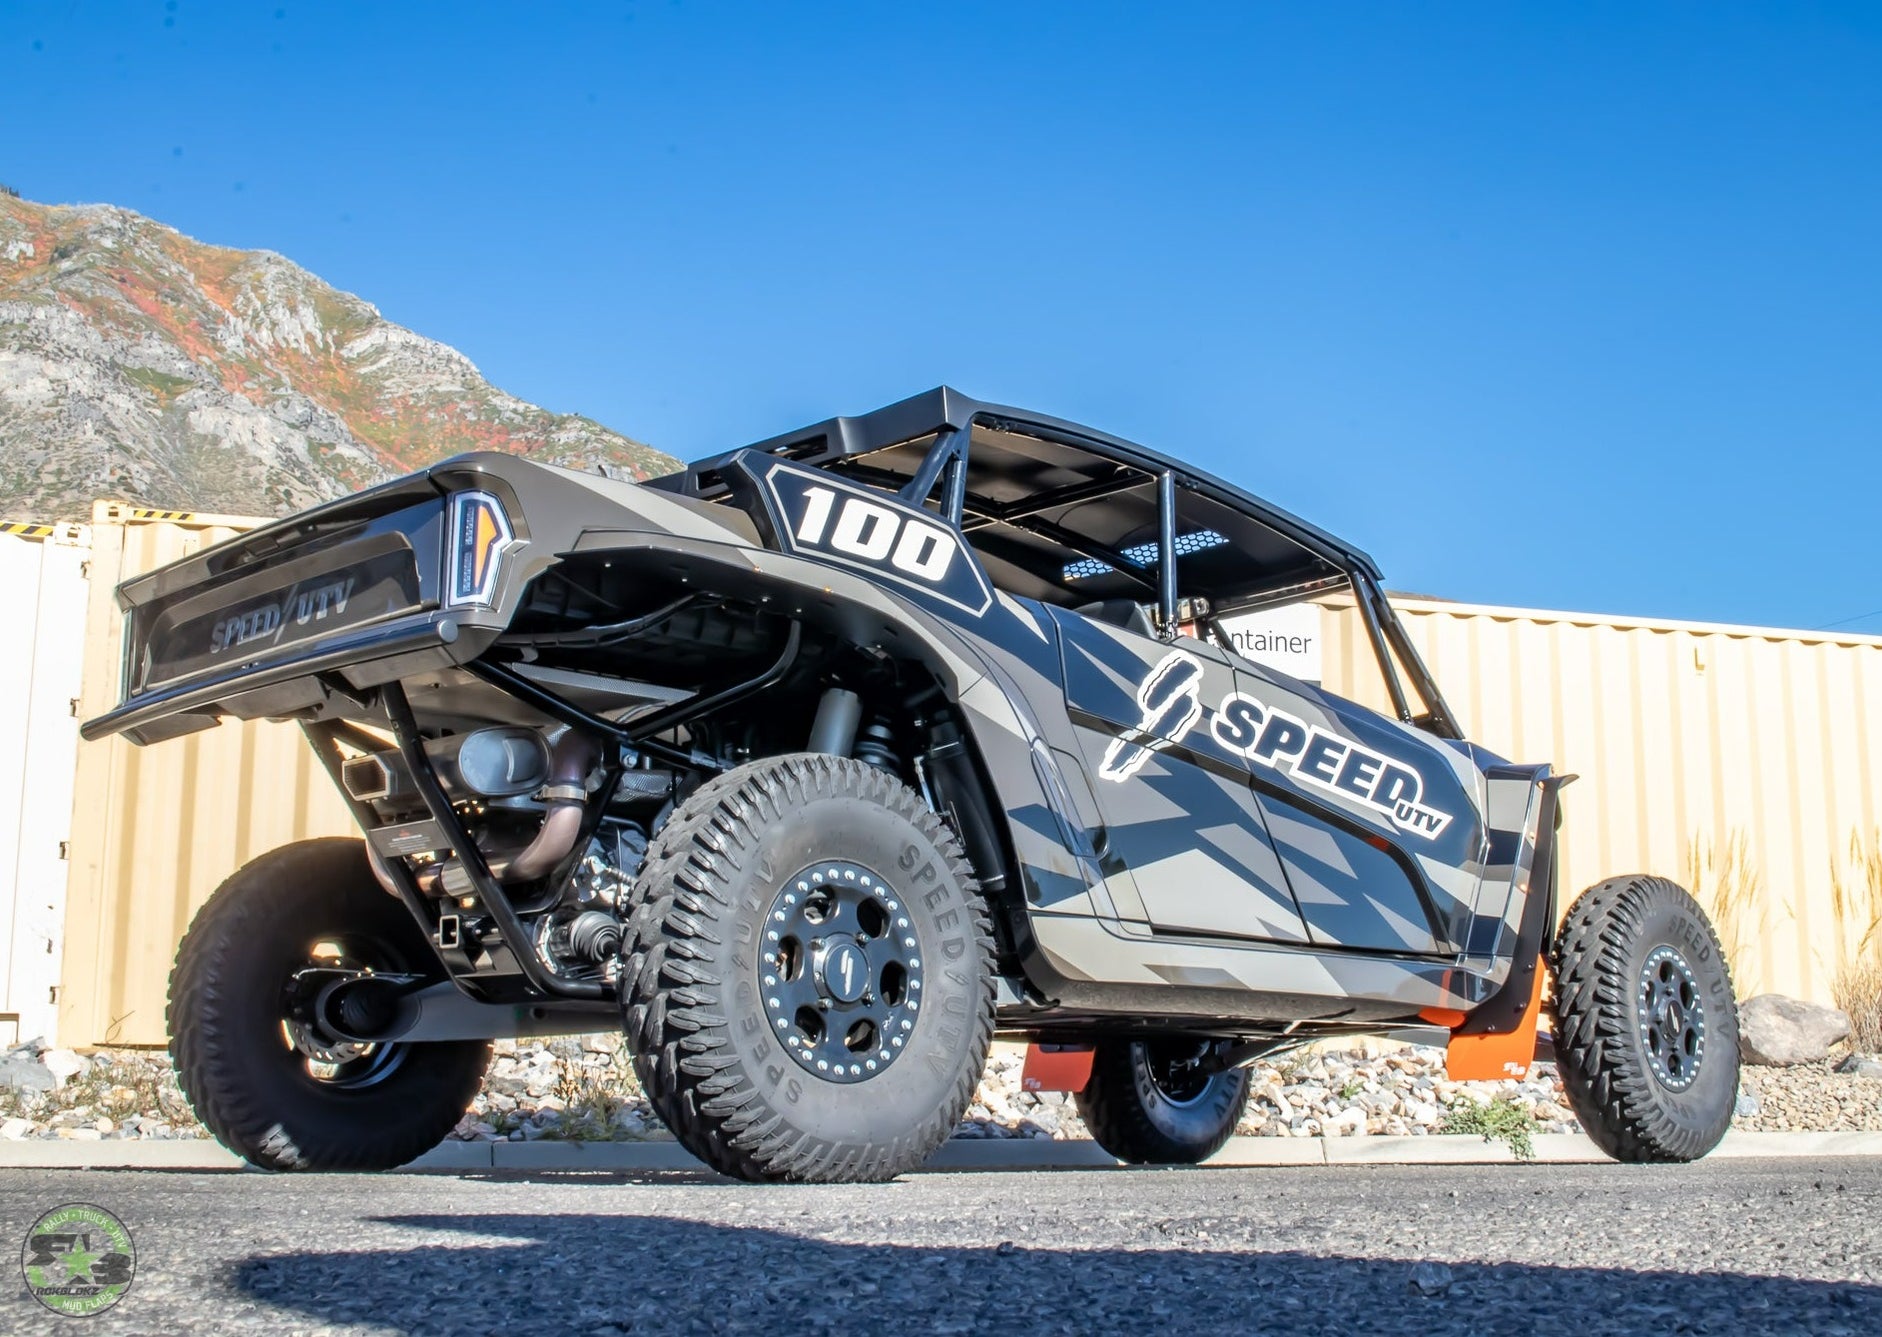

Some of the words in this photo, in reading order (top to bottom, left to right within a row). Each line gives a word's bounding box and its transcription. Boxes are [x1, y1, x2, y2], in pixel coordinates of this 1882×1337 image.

[797, 487, 956, 580] 100
[1216, 698, 1419, 805] SPEED
[1395, 802, 1443, 833] UTV
